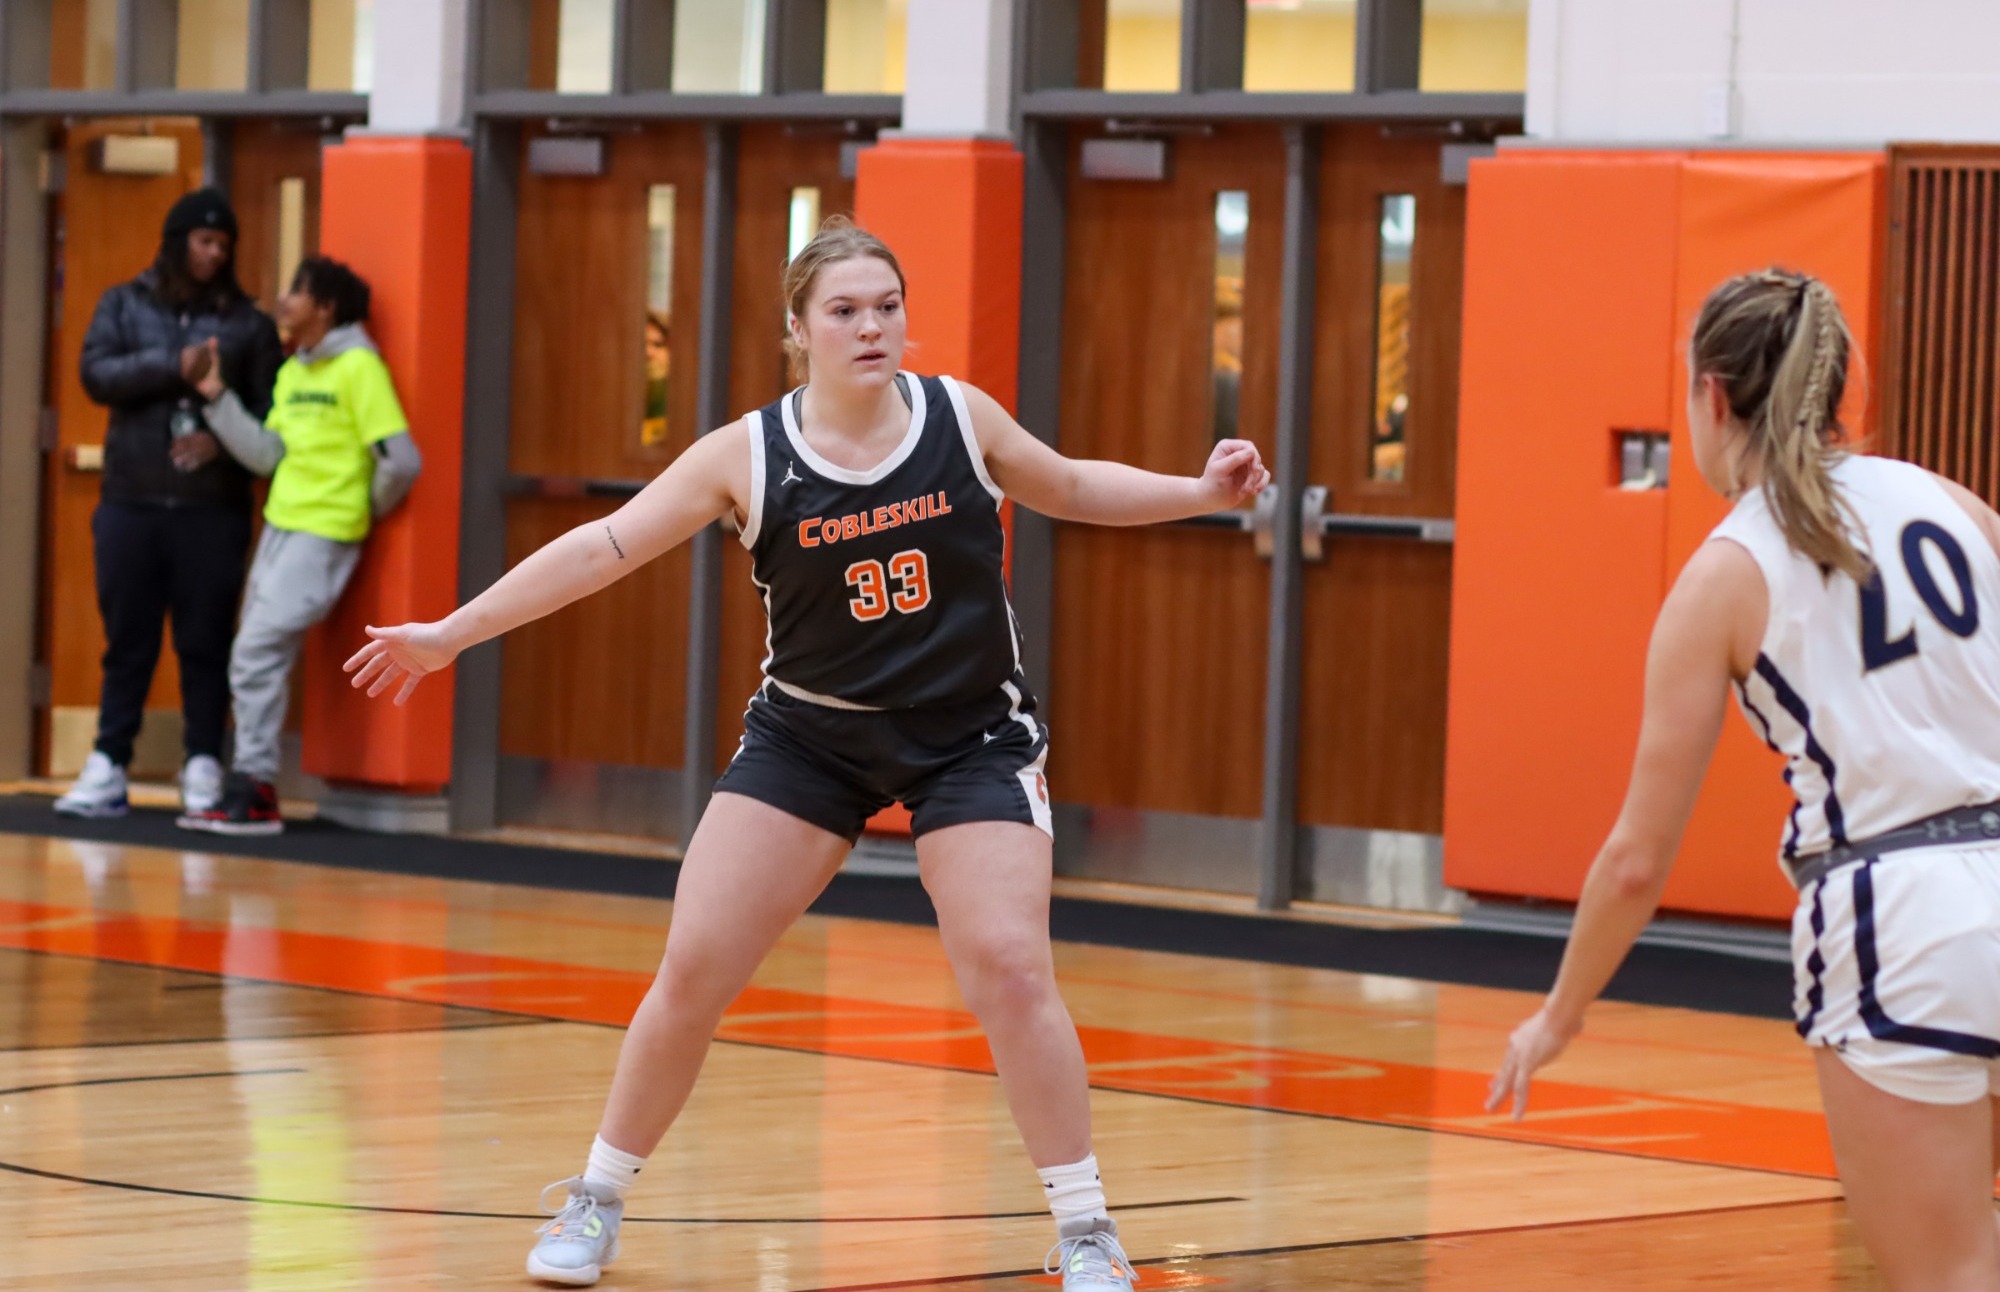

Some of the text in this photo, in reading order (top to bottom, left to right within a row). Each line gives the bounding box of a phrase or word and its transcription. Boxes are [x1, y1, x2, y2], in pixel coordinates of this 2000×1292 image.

[798, 490, 952, 548] COBLESKILL
[844, 548, 932, 623] 33
[1858, 518, 1980, 677] 20
